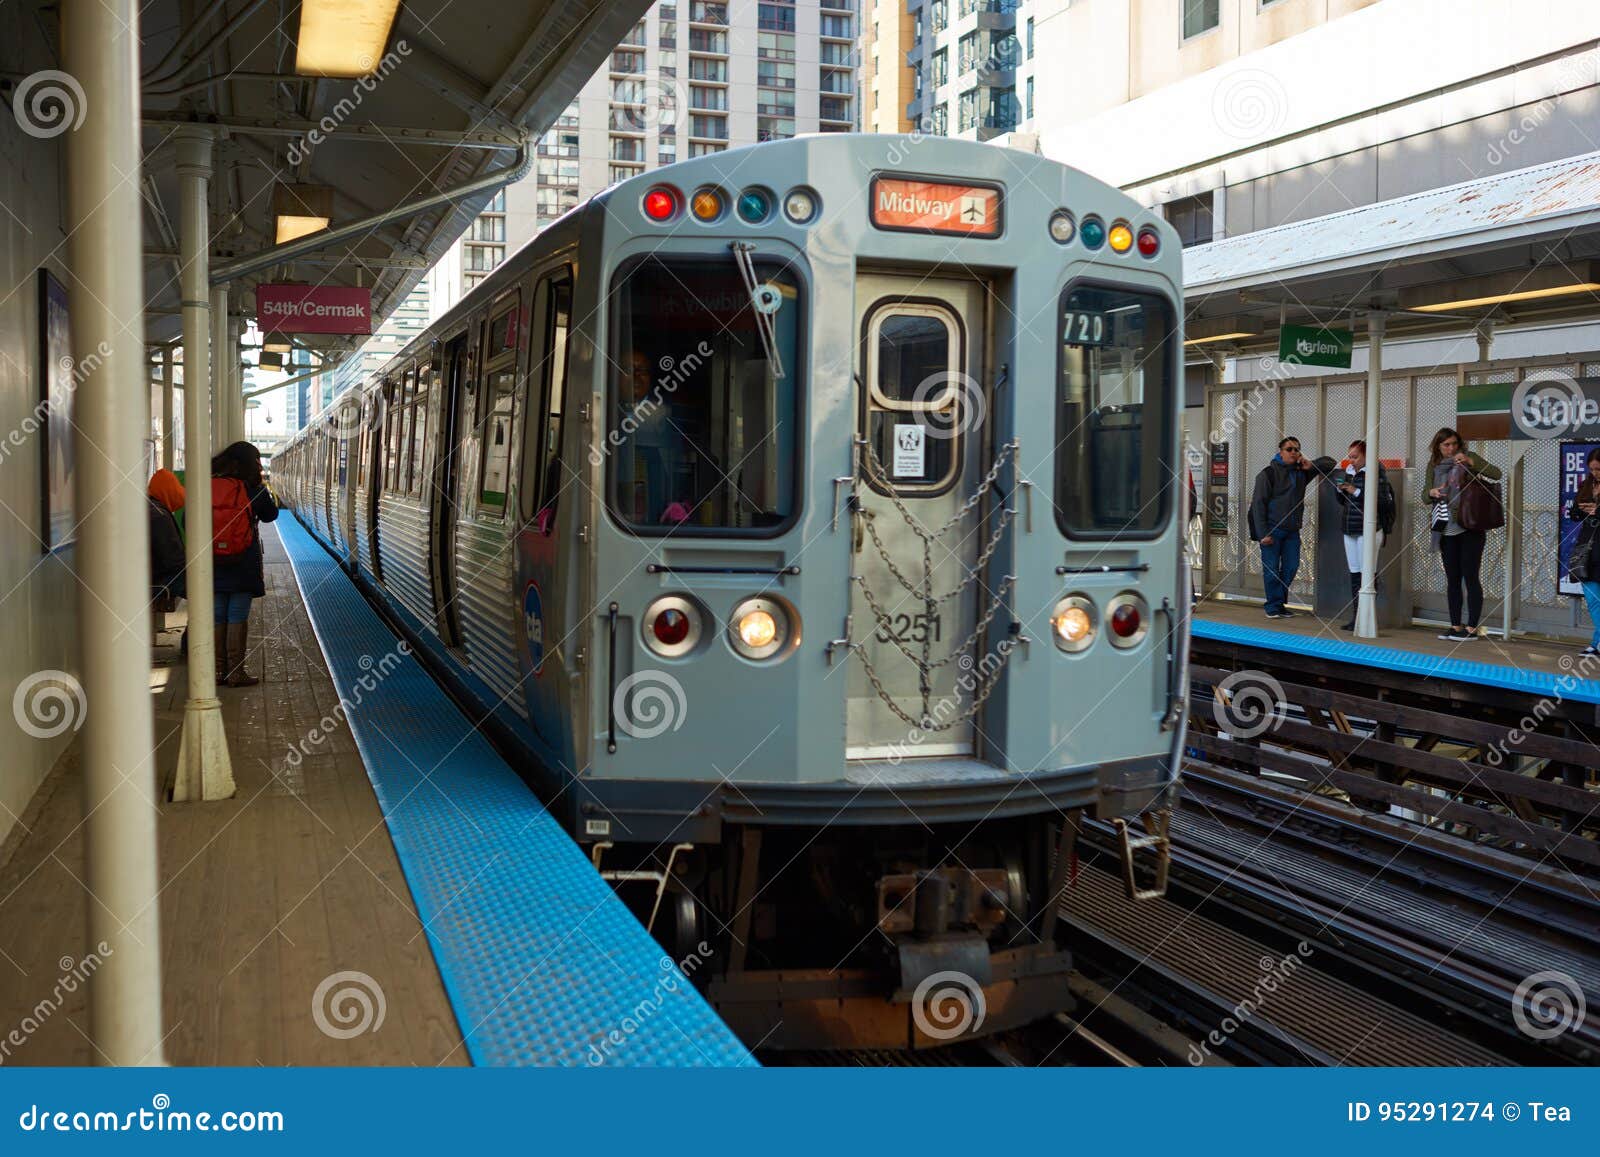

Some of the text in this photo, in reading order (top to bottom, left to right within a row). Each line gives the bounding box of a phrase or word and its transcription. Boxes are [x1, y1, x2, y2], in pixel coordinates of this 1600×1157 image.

[880, 191, 955, 220] Midway
[263, 300, 365, 317] 54th/Cermak
[1063, 312, 1103, 341] 720
[1296, 338, 1338, 355] Harlem
[1521, 393, 1600, 428] State
[876, 613, 942, 643] 3251
